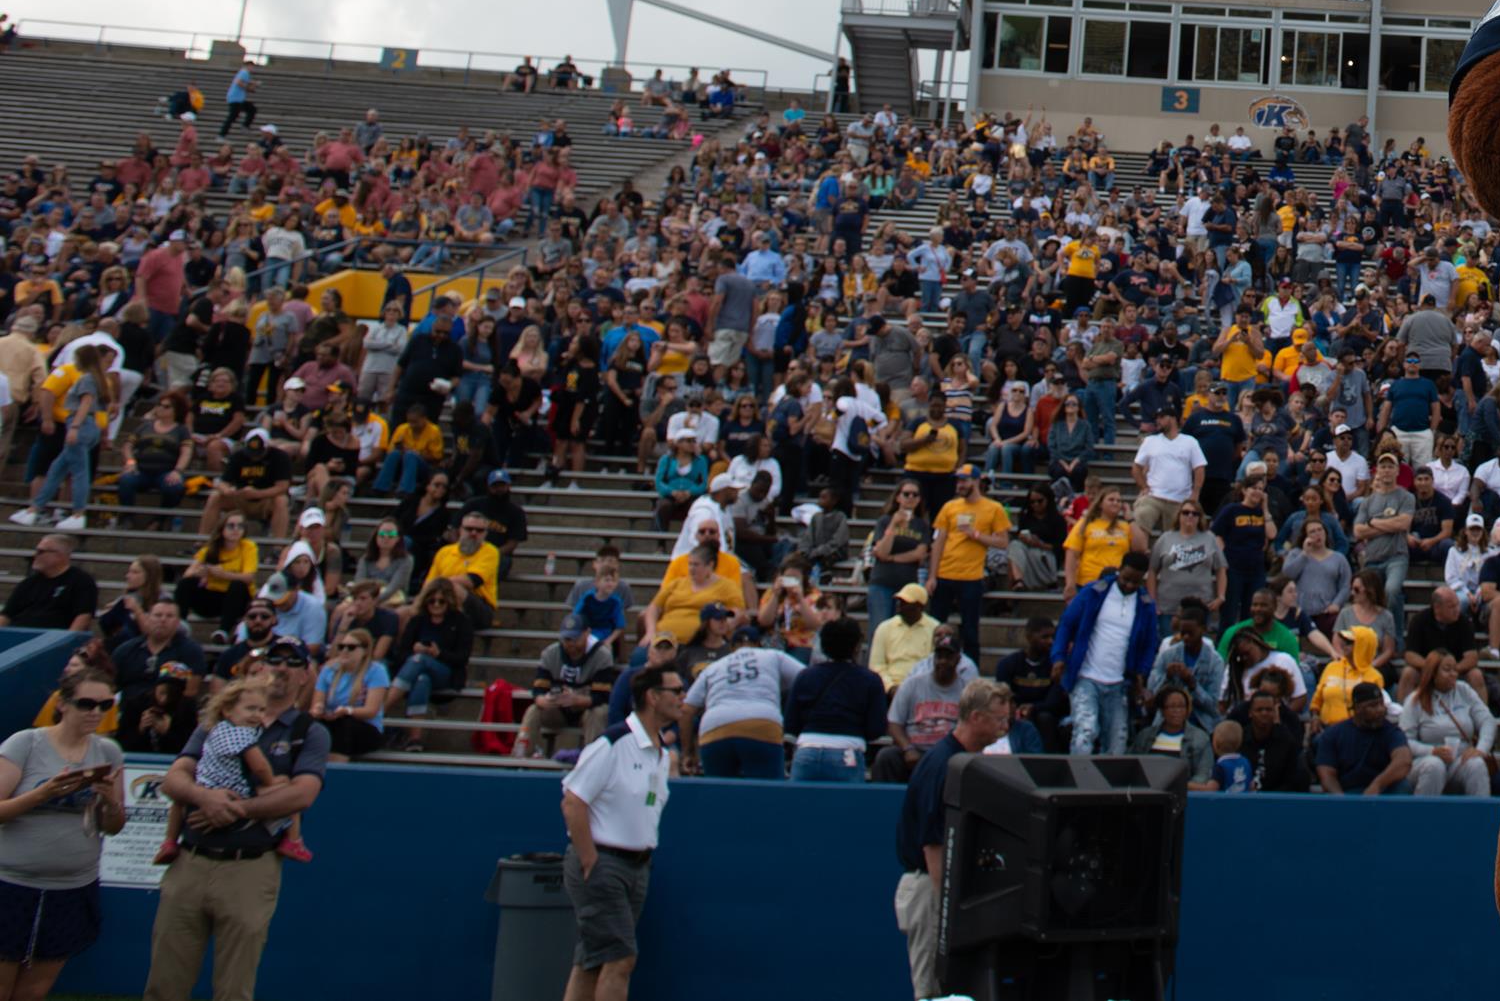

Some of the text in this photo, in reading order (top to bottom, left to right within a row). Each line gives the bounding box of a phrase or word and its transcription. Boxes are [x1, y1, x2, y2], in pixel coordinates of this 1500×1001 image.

[391, 49, 406, 69] 2
[1173, 90, 1190, 110] 3
[1262, 103, 1293, 127] K
[727, 659, 759, 684] 55
